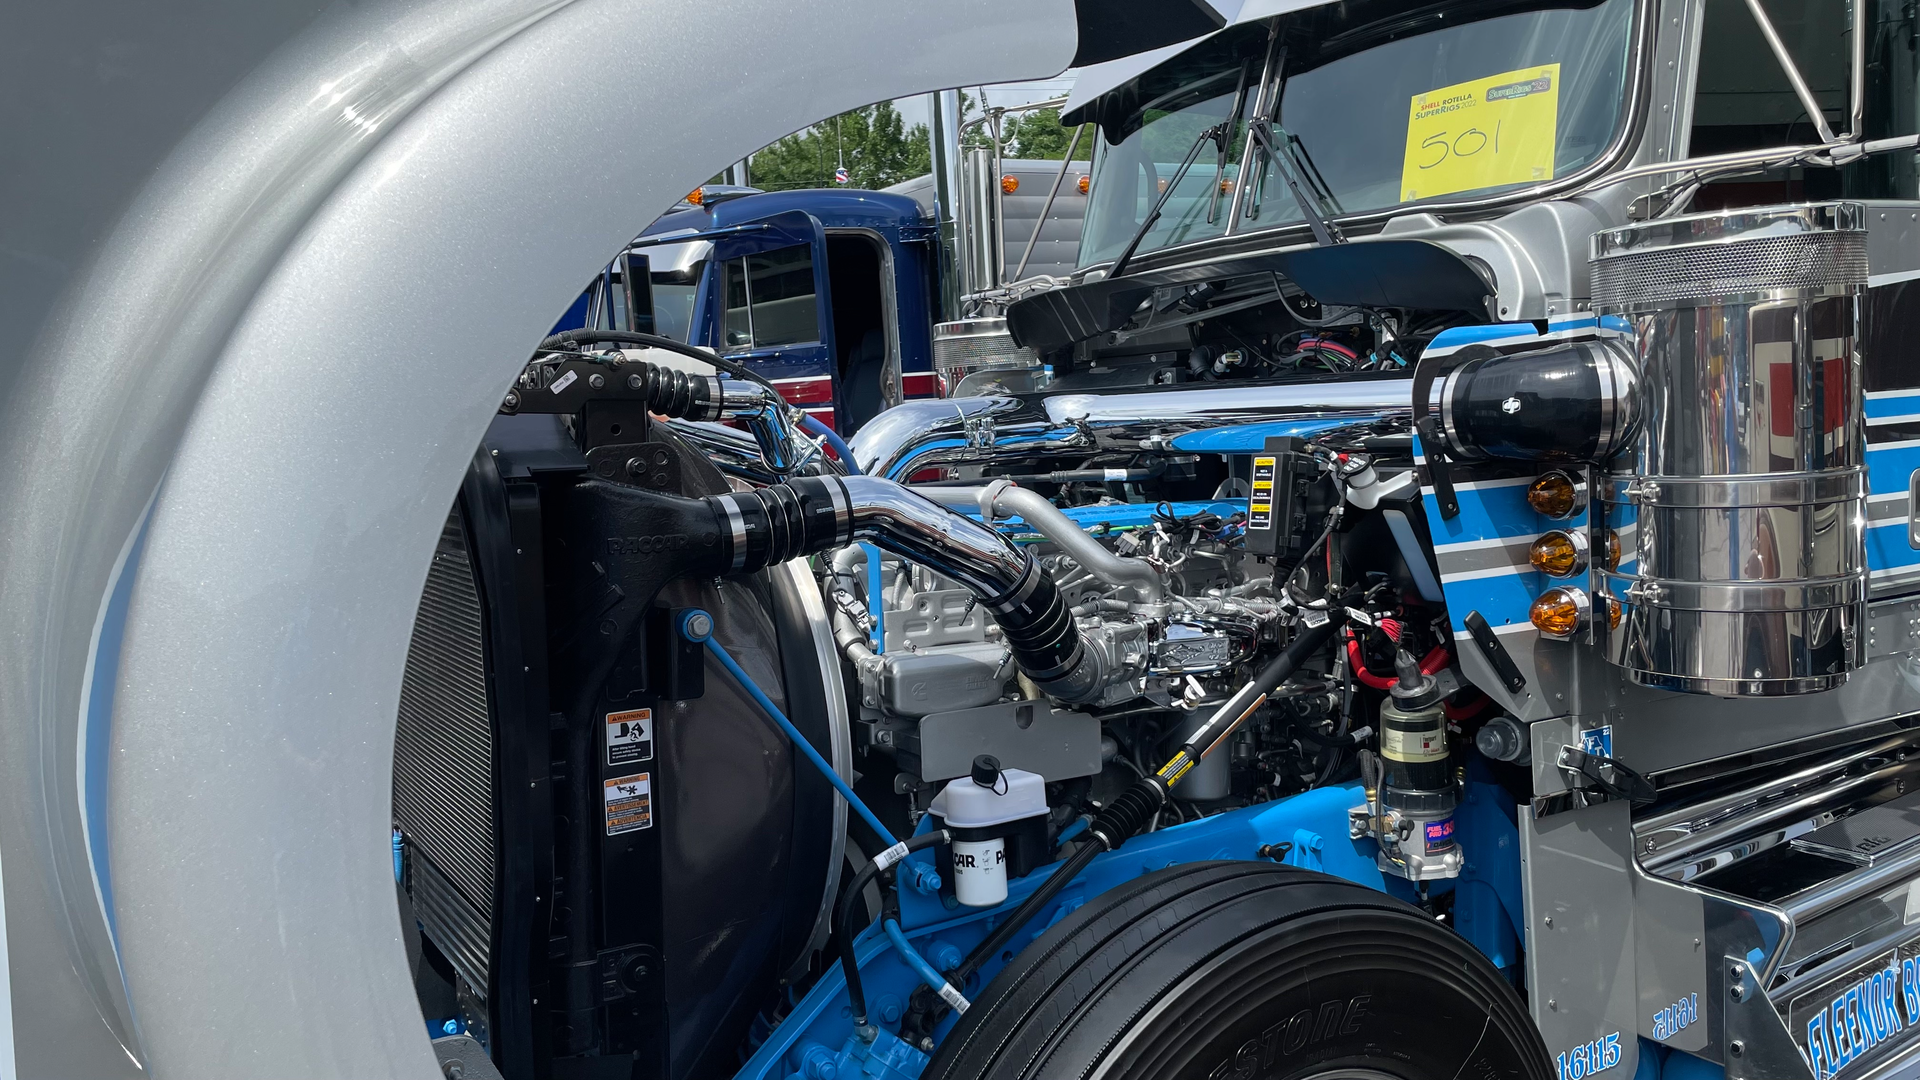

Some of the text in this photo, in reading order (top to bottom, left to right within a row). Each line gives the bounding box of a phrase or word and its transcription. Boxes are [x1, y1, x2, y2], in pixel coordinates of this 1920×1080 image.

[1415, 100, 1477, 120] SUPERRIGS 2022
[1421, 93, 1472, 111] SHELL ROTELLA
[1418, 119, 1501, 169] 501
[616, 712, 646, 720] WARNING
[1807, 968, 1903, 1080] FLEENOR
[1557, 1031, 1623, 1080] 16115
